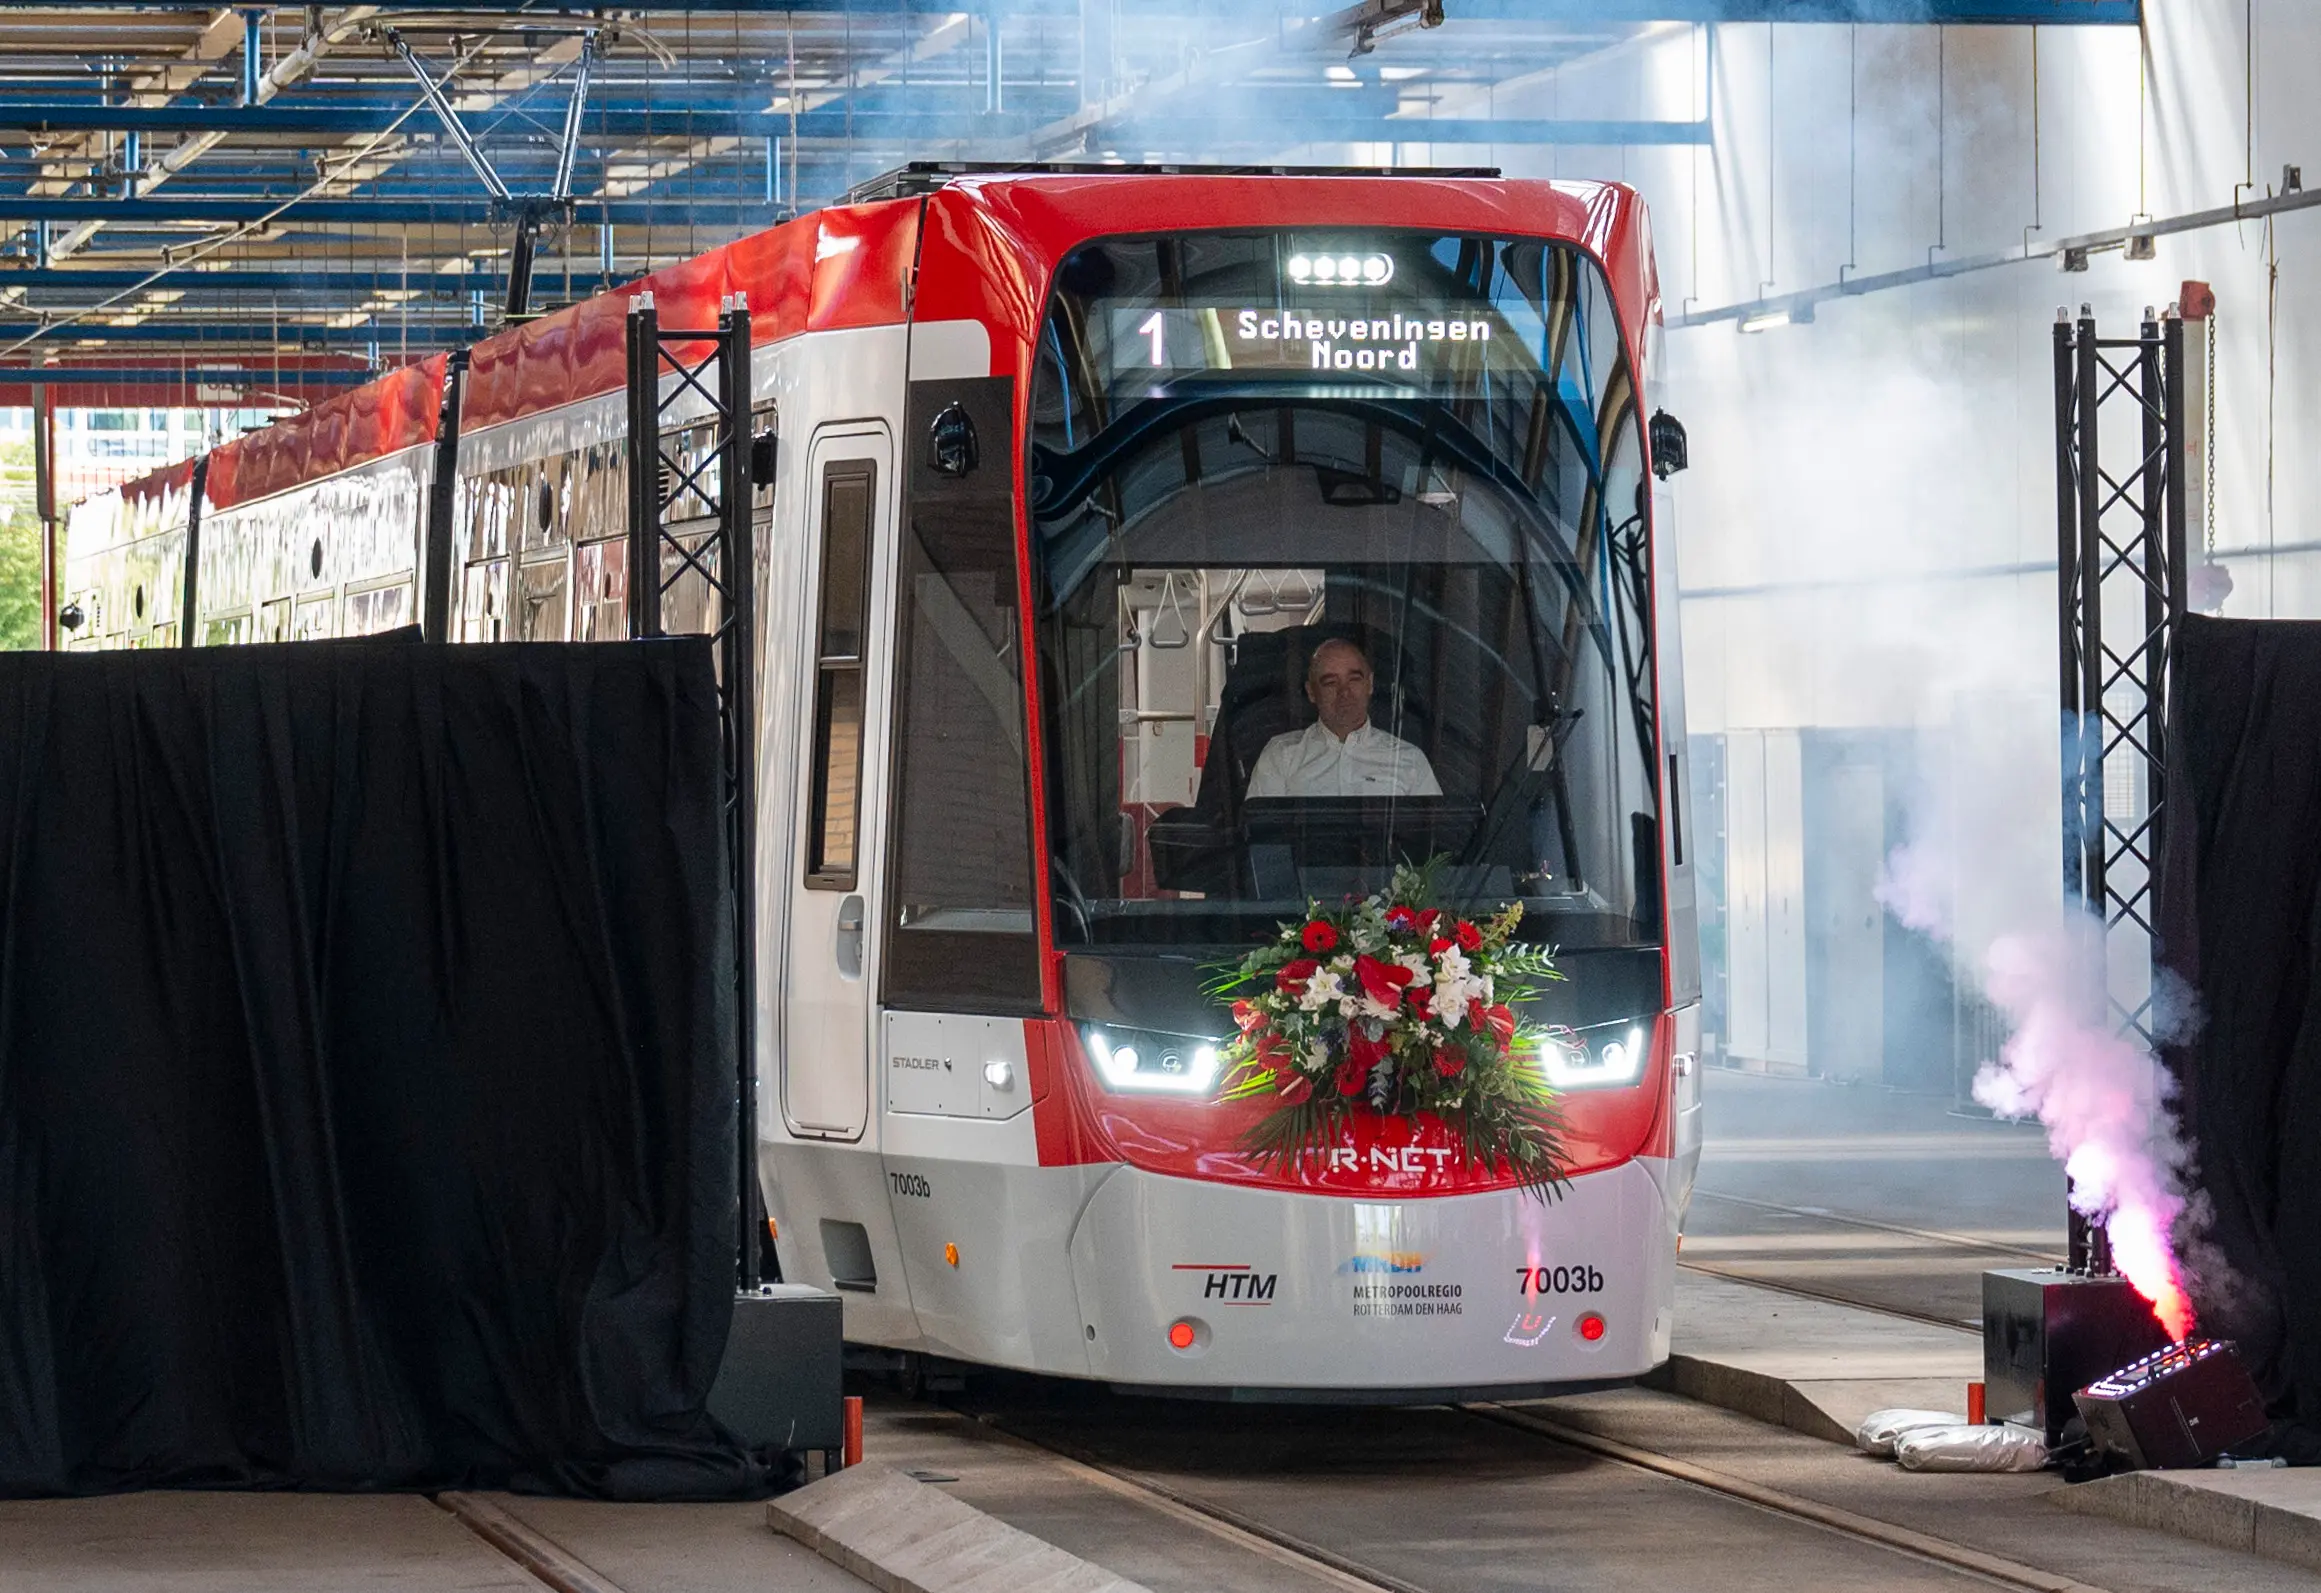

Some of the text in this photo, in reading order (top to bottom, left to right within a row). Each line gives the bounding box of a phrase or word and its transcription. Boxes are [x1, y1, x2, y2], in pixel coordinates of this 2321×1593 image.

[1139, 311, 1162, 366] 1
[1238, 310, 1491, 341] Scheveningen
[1312, 341, 1416, 369] Noord
[892, 1056, 940, 1070] STADLER
[890, 1172, 931, 1198] 7003b
[1204, 1273, 1277, 1299] HTM
[1353, 1285, 1463, 1299] METROPOOLREGIO
[1516, 1265, 1604, 1294] 7003b
[1353, 1303, 1463, 1316] ROTTERDAM DEN HAAG
